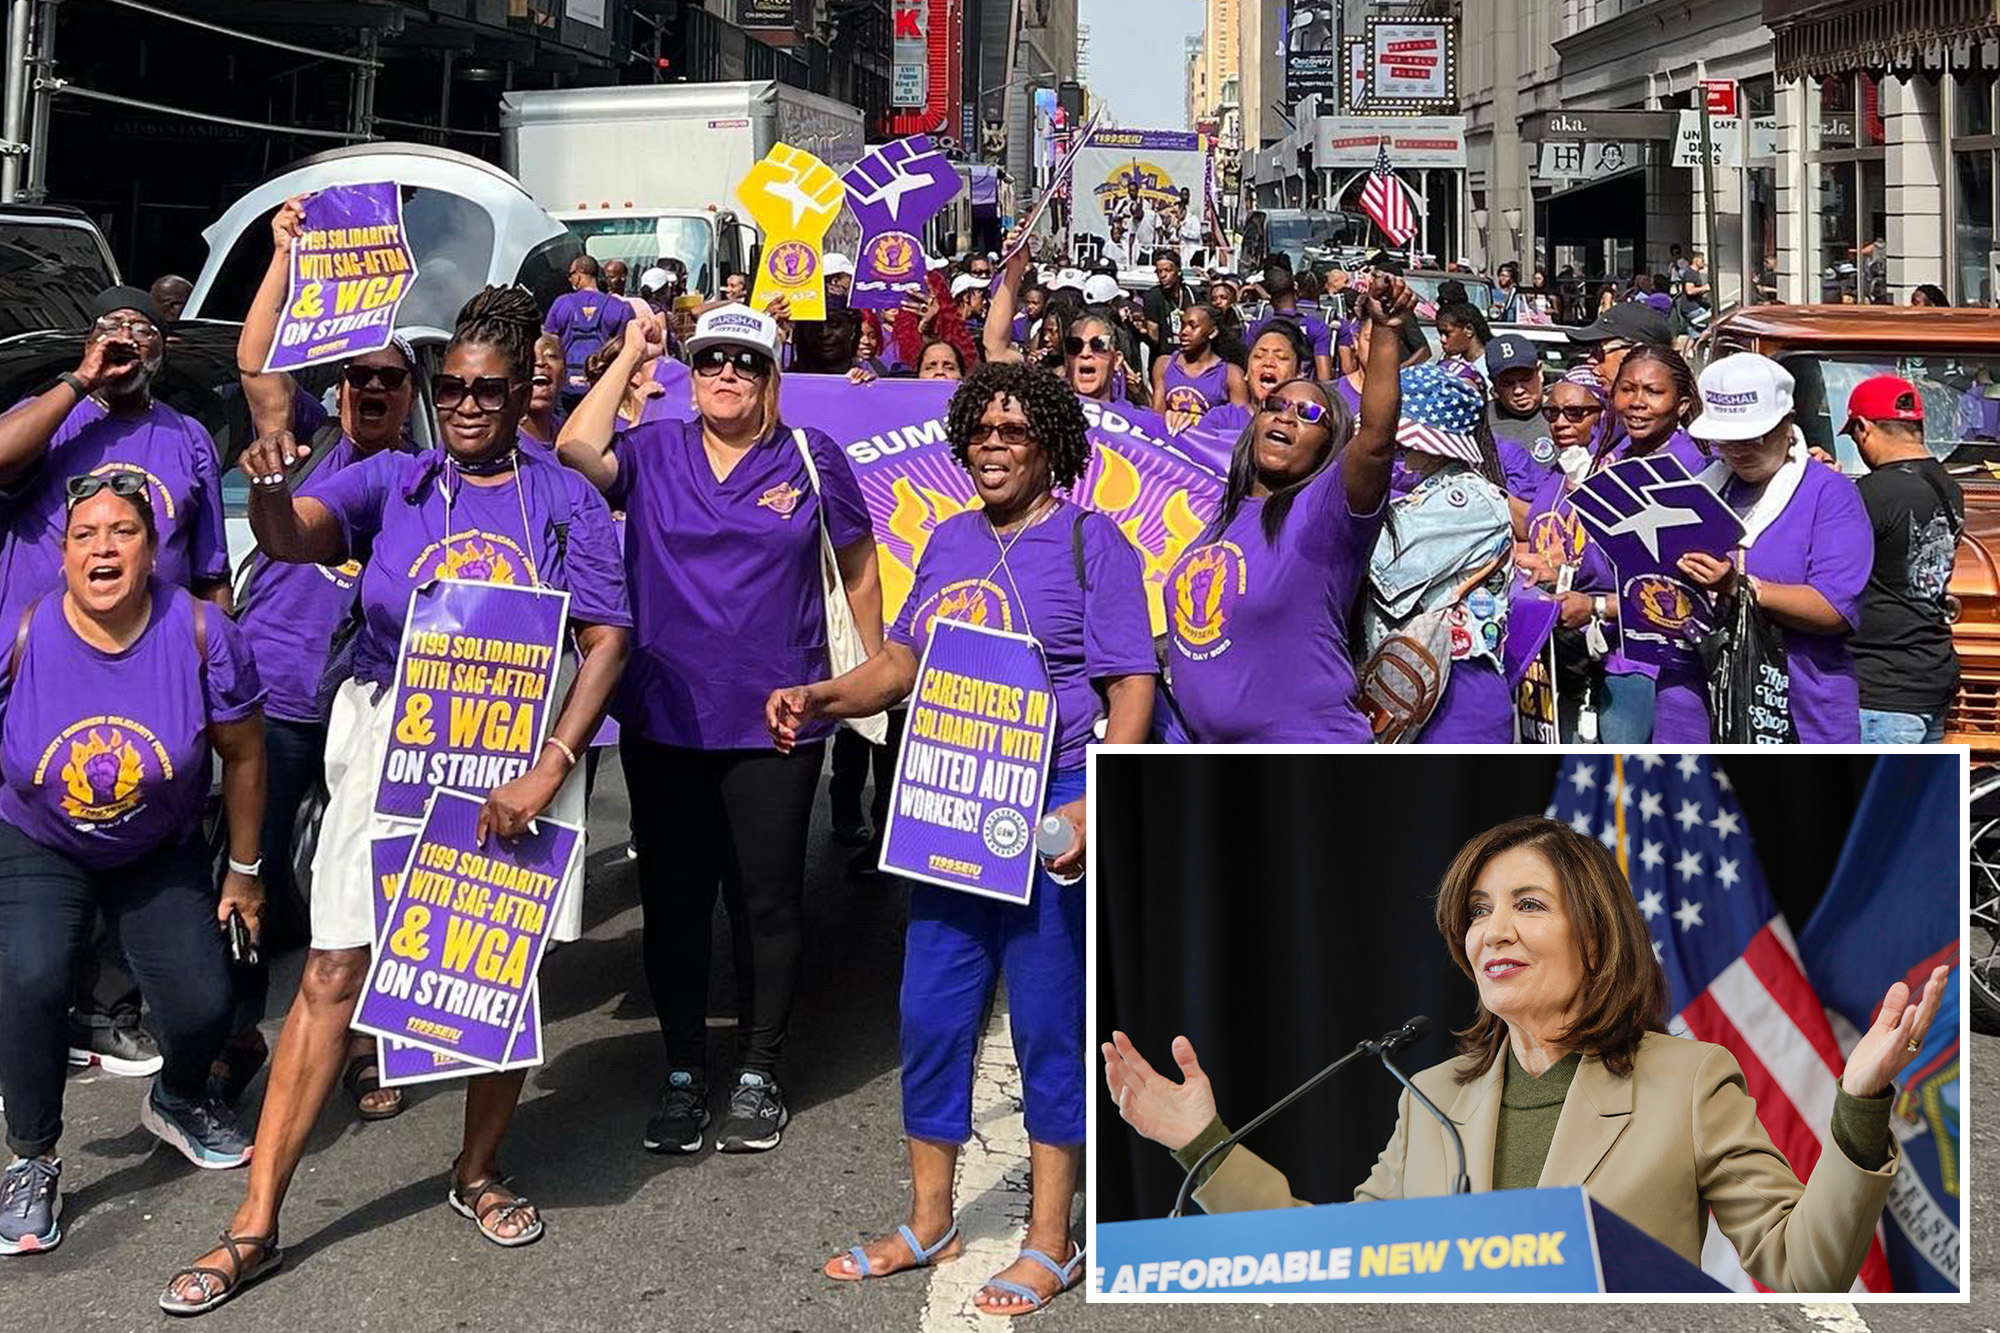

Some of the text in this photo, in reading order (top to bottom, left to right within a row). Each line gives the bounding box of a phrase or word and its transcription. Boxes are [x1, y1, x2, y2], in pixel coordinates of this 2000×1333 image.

[1551, 115, 1588, 132] aka.
[1683, 131, 1700, 140] UN
[1713, 121, 1737, 129] CAFE
[301, 225, 400, 250] 1199 SOLIDARITY
[298, 247, 410, 280] WITH SAG-AFTRA
[291, 273, 406, 318] & WGA
[280, 305, 391, 347] ON STRIKE!
[709, 315, 762, 331] MARSHAL
[1501, 342, 1515, 359] B
[1706, 391, 1757, 404] MARSHAL
[846, 415, 951, 464] SUM
[410, 631, 553, 670] 1199 SOLIDARITY
[405, 657, 547, 701] WITH SAG-AFTRA
[920, 667, 1050, 728] CAREGIVERS IN
[1755, 684, 1788, 710] You
[396, 693, 535, 754] & WGA
[912, 706, 1045, 763] SOLIDARITY WITH
[386, 750, 427, 785] ON
[904, 740, 1039, 809] UNITED AUTO
[899, 783, 983, 835] WORKERS!
[418, 842, 560, 900] 1199 SOLIDARITY
[928, 854, 984, 879] 1199SEIU
[407, 867, 457, 909] WITH
[452, 881, 549, 936] SAG-AFTRA
[389, 904, 532, 990] & WGA
[374, 959, 520, 1032] ON STRIKE!
[405, 1016, 463, 1044] 1199SEIU
[1108, 1247, 1353, 1294] AFFORDABLE
[1359, 1239, 1450, 1278] NEW
[1456, 1231, 1567, 1272] YORK
